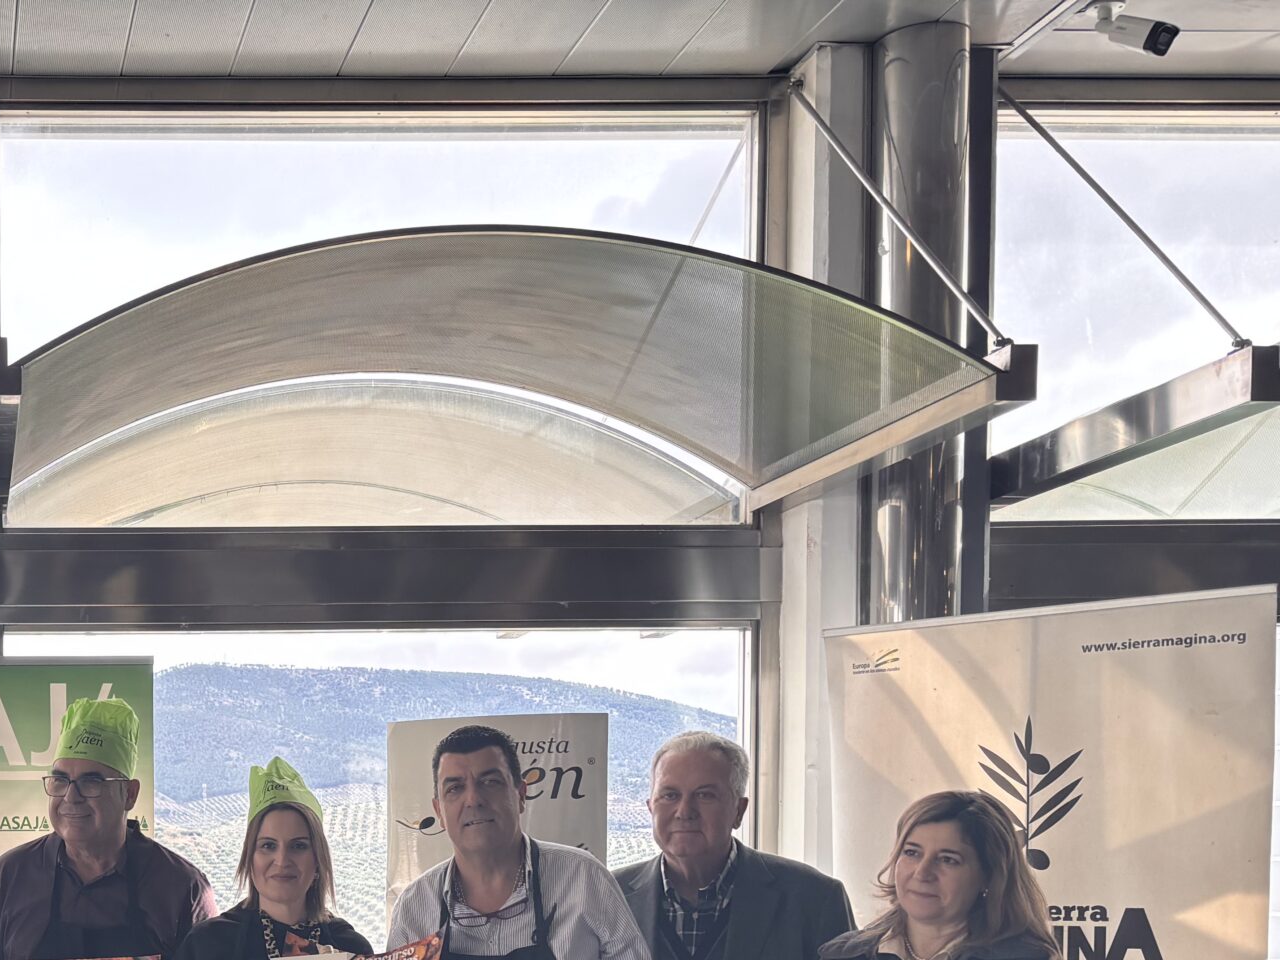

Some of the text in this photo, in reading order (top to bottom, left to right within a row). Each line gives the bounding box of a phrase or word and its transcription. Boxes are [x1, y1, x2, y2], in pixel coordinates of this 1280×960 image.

[1081, 632, 1247, 653] www.sierramagina.org
[514, 737, 570, 755] usta
[521, 758, 586, 801] én
[0, 816, 49, 831] ASAJA
[1048, 904, 1109, 922] erra
